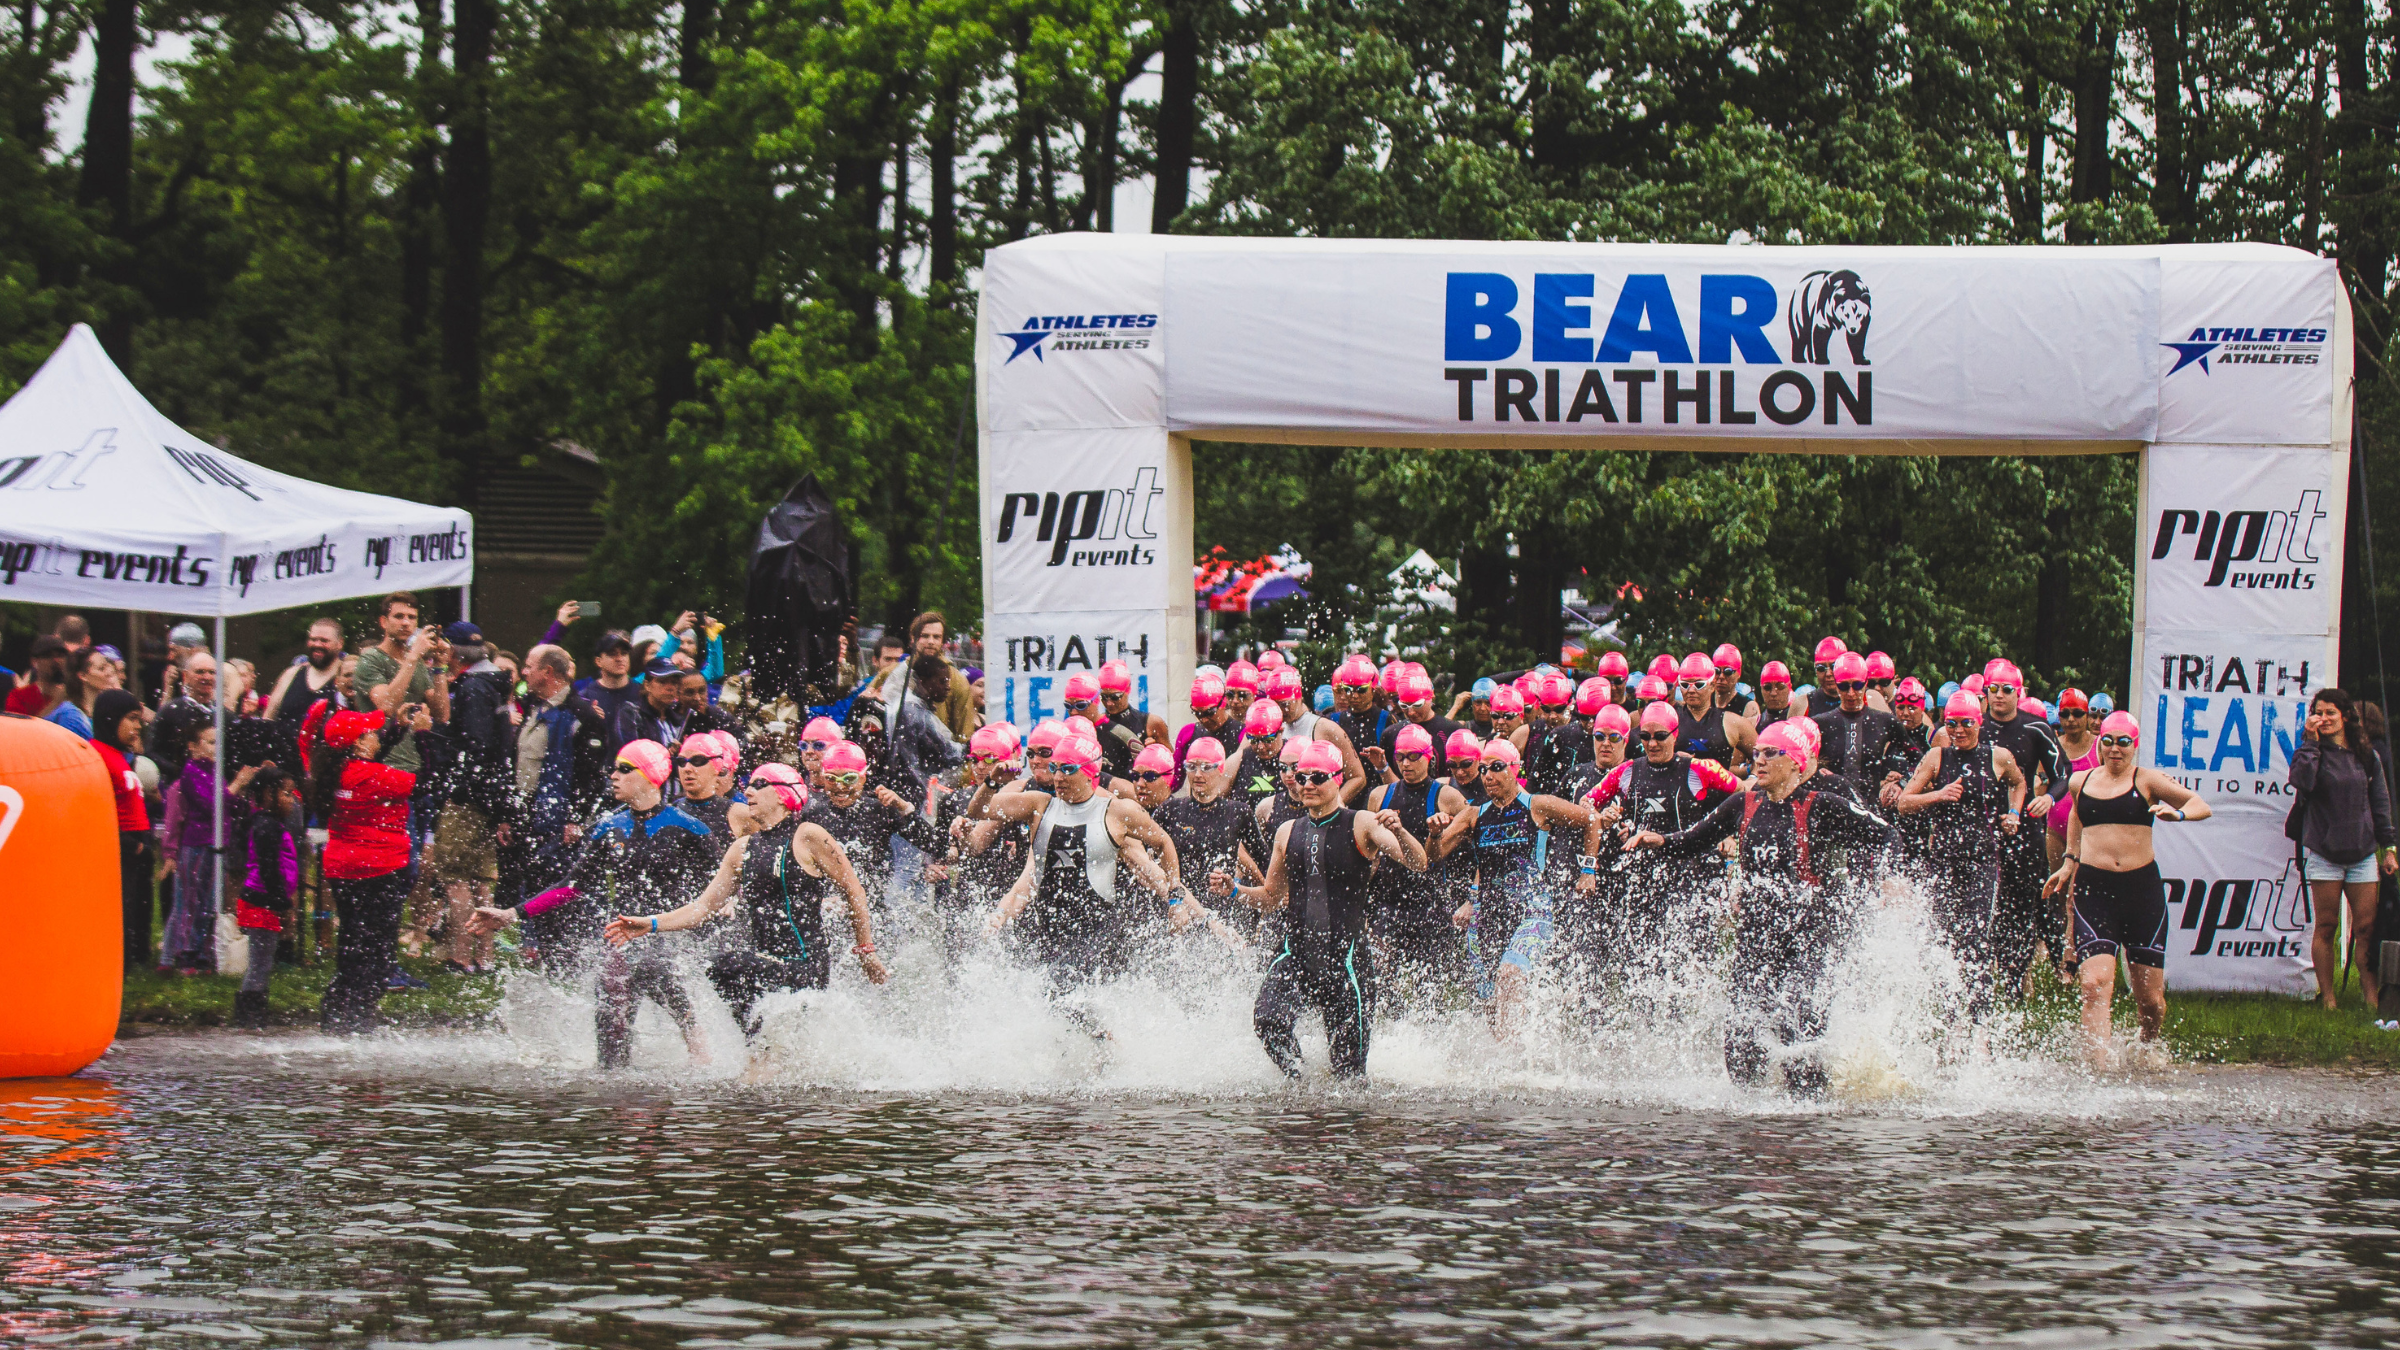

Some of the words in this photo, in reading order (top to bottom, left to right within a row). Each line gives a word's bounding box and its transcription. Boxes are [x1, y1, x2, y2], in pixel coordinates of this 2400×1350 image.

[1022, 314, 1159, 330] ATHLETES
[1444, 271, 1784, 364] BEAR
[1050, 339, 1150, 351] ATHLETES
[2187, 327, 2328, 342] ATHLETES
[2217, 353, 2320, 365] ATHLETES
[1443, 367, 1873, 426] TRIATHLON
[407, 520, 467, 563] events
[76, 544, 214, 586] events
[275, 533, 337, 580] events
[1071, 544, 1156, 567] events
[2230, 567, 2317, 589] events
[1005, 633, 1149, 672] TRIATH
[2160, 653, 2310, 696] TRIATH
[2154, 694, 2307, 774] LEAN
[2216, 778, 2241, 793] TO
[2254, 780, 2294, 796] RAC
[1752, 845, 1780, 861] TYR
[2217, 935, 2302, 958] events
